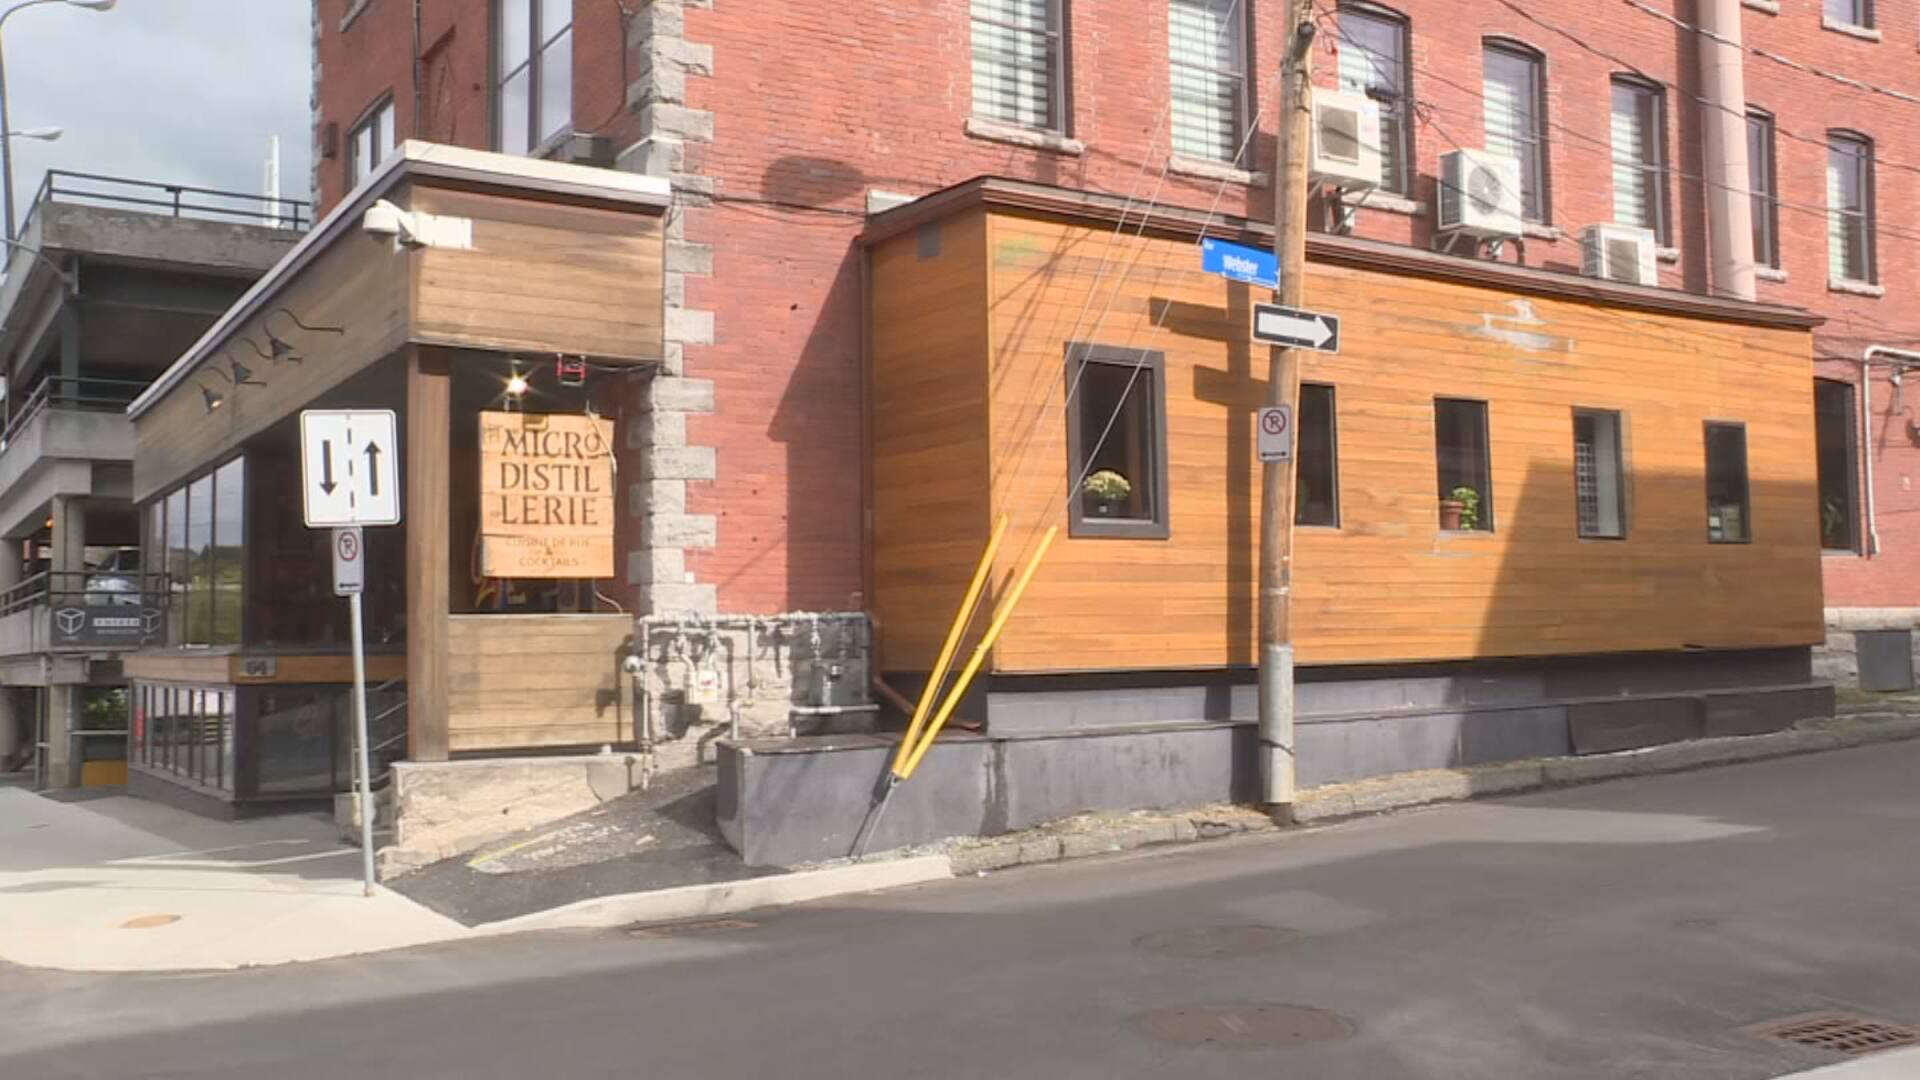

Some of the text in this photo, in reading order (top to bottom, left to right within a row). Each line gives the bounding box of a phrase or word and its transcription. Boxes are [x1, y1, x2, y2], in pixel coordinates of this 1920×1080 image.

[501, 429, 609, 459] MICRO
[501, 461, 600, 492] DISTIL
[502, 495, 599, 525] LERIE
